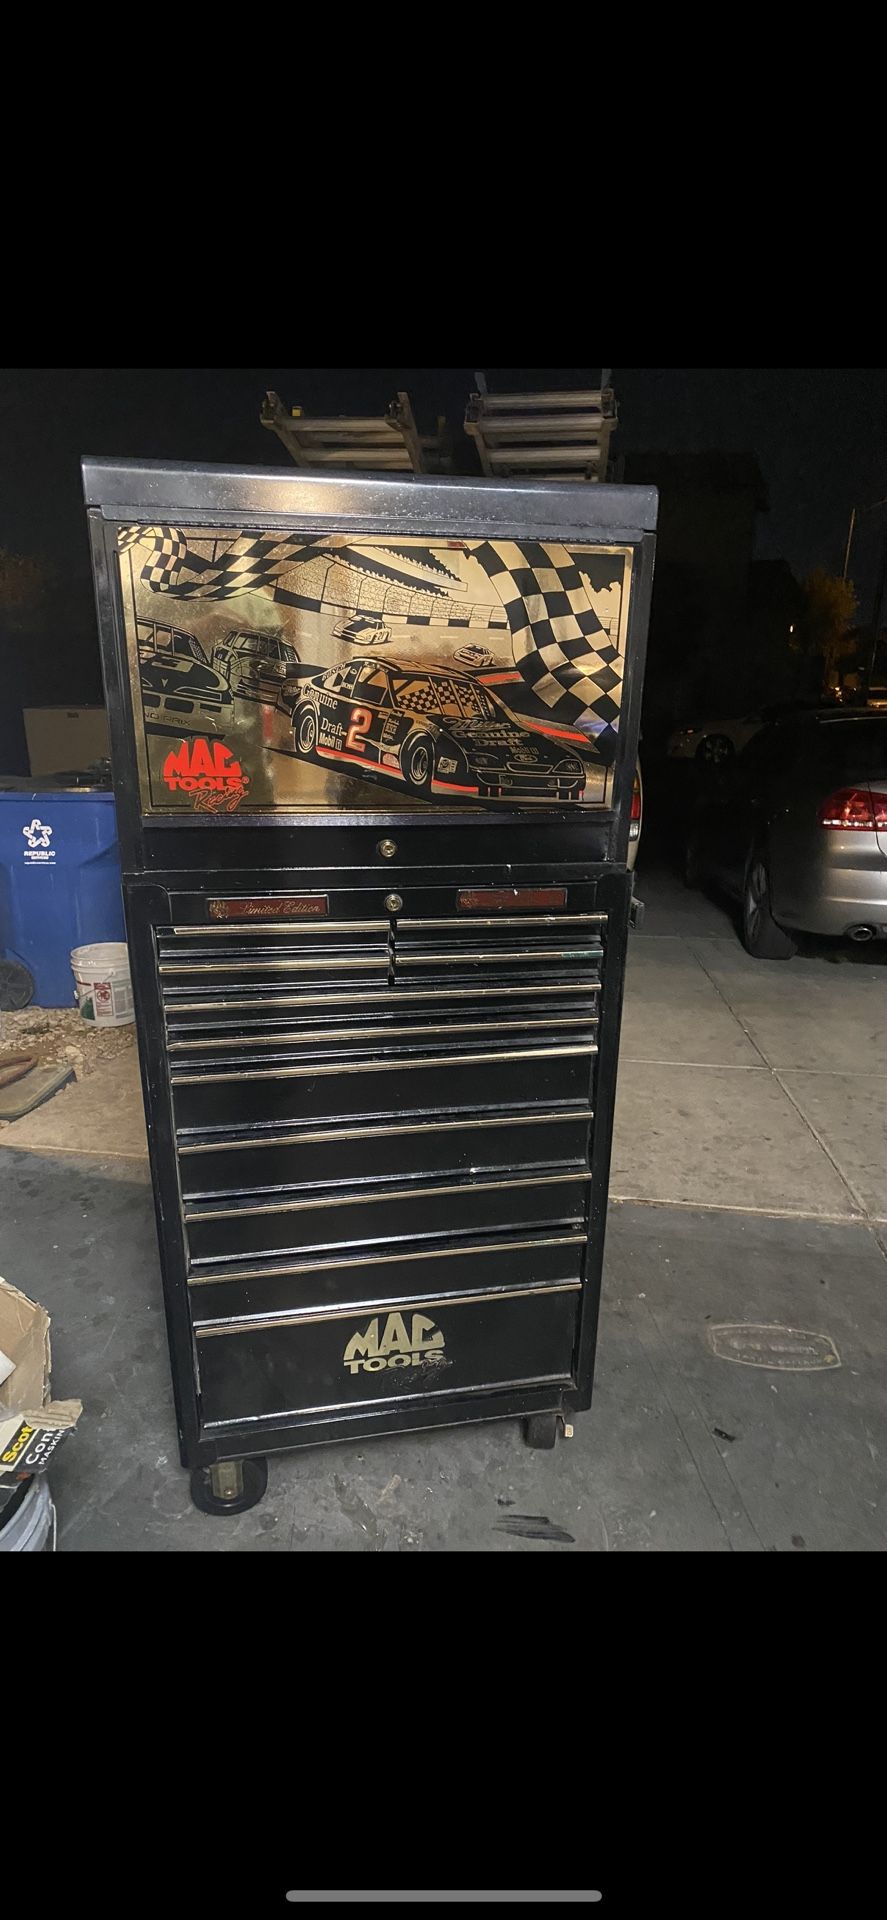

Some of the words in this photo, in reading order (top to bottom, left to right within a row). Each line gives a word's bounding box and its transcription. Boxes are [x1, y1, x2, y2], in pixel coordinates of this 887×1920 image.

[301, 683, 339, 711] Genuine
[345, 706, 373, 753] 2
[451, 729, 531, 739] Genuine
[163, 738, 242, 777] MAC
[188, 785, 249, 814] Racing
[240, 901, 282, 915] Limited
[283, 900, 321, 914] Edition
[343, 1311, 446, 1361] MAC
[343, 1349, 445, 1375] TOOLS
